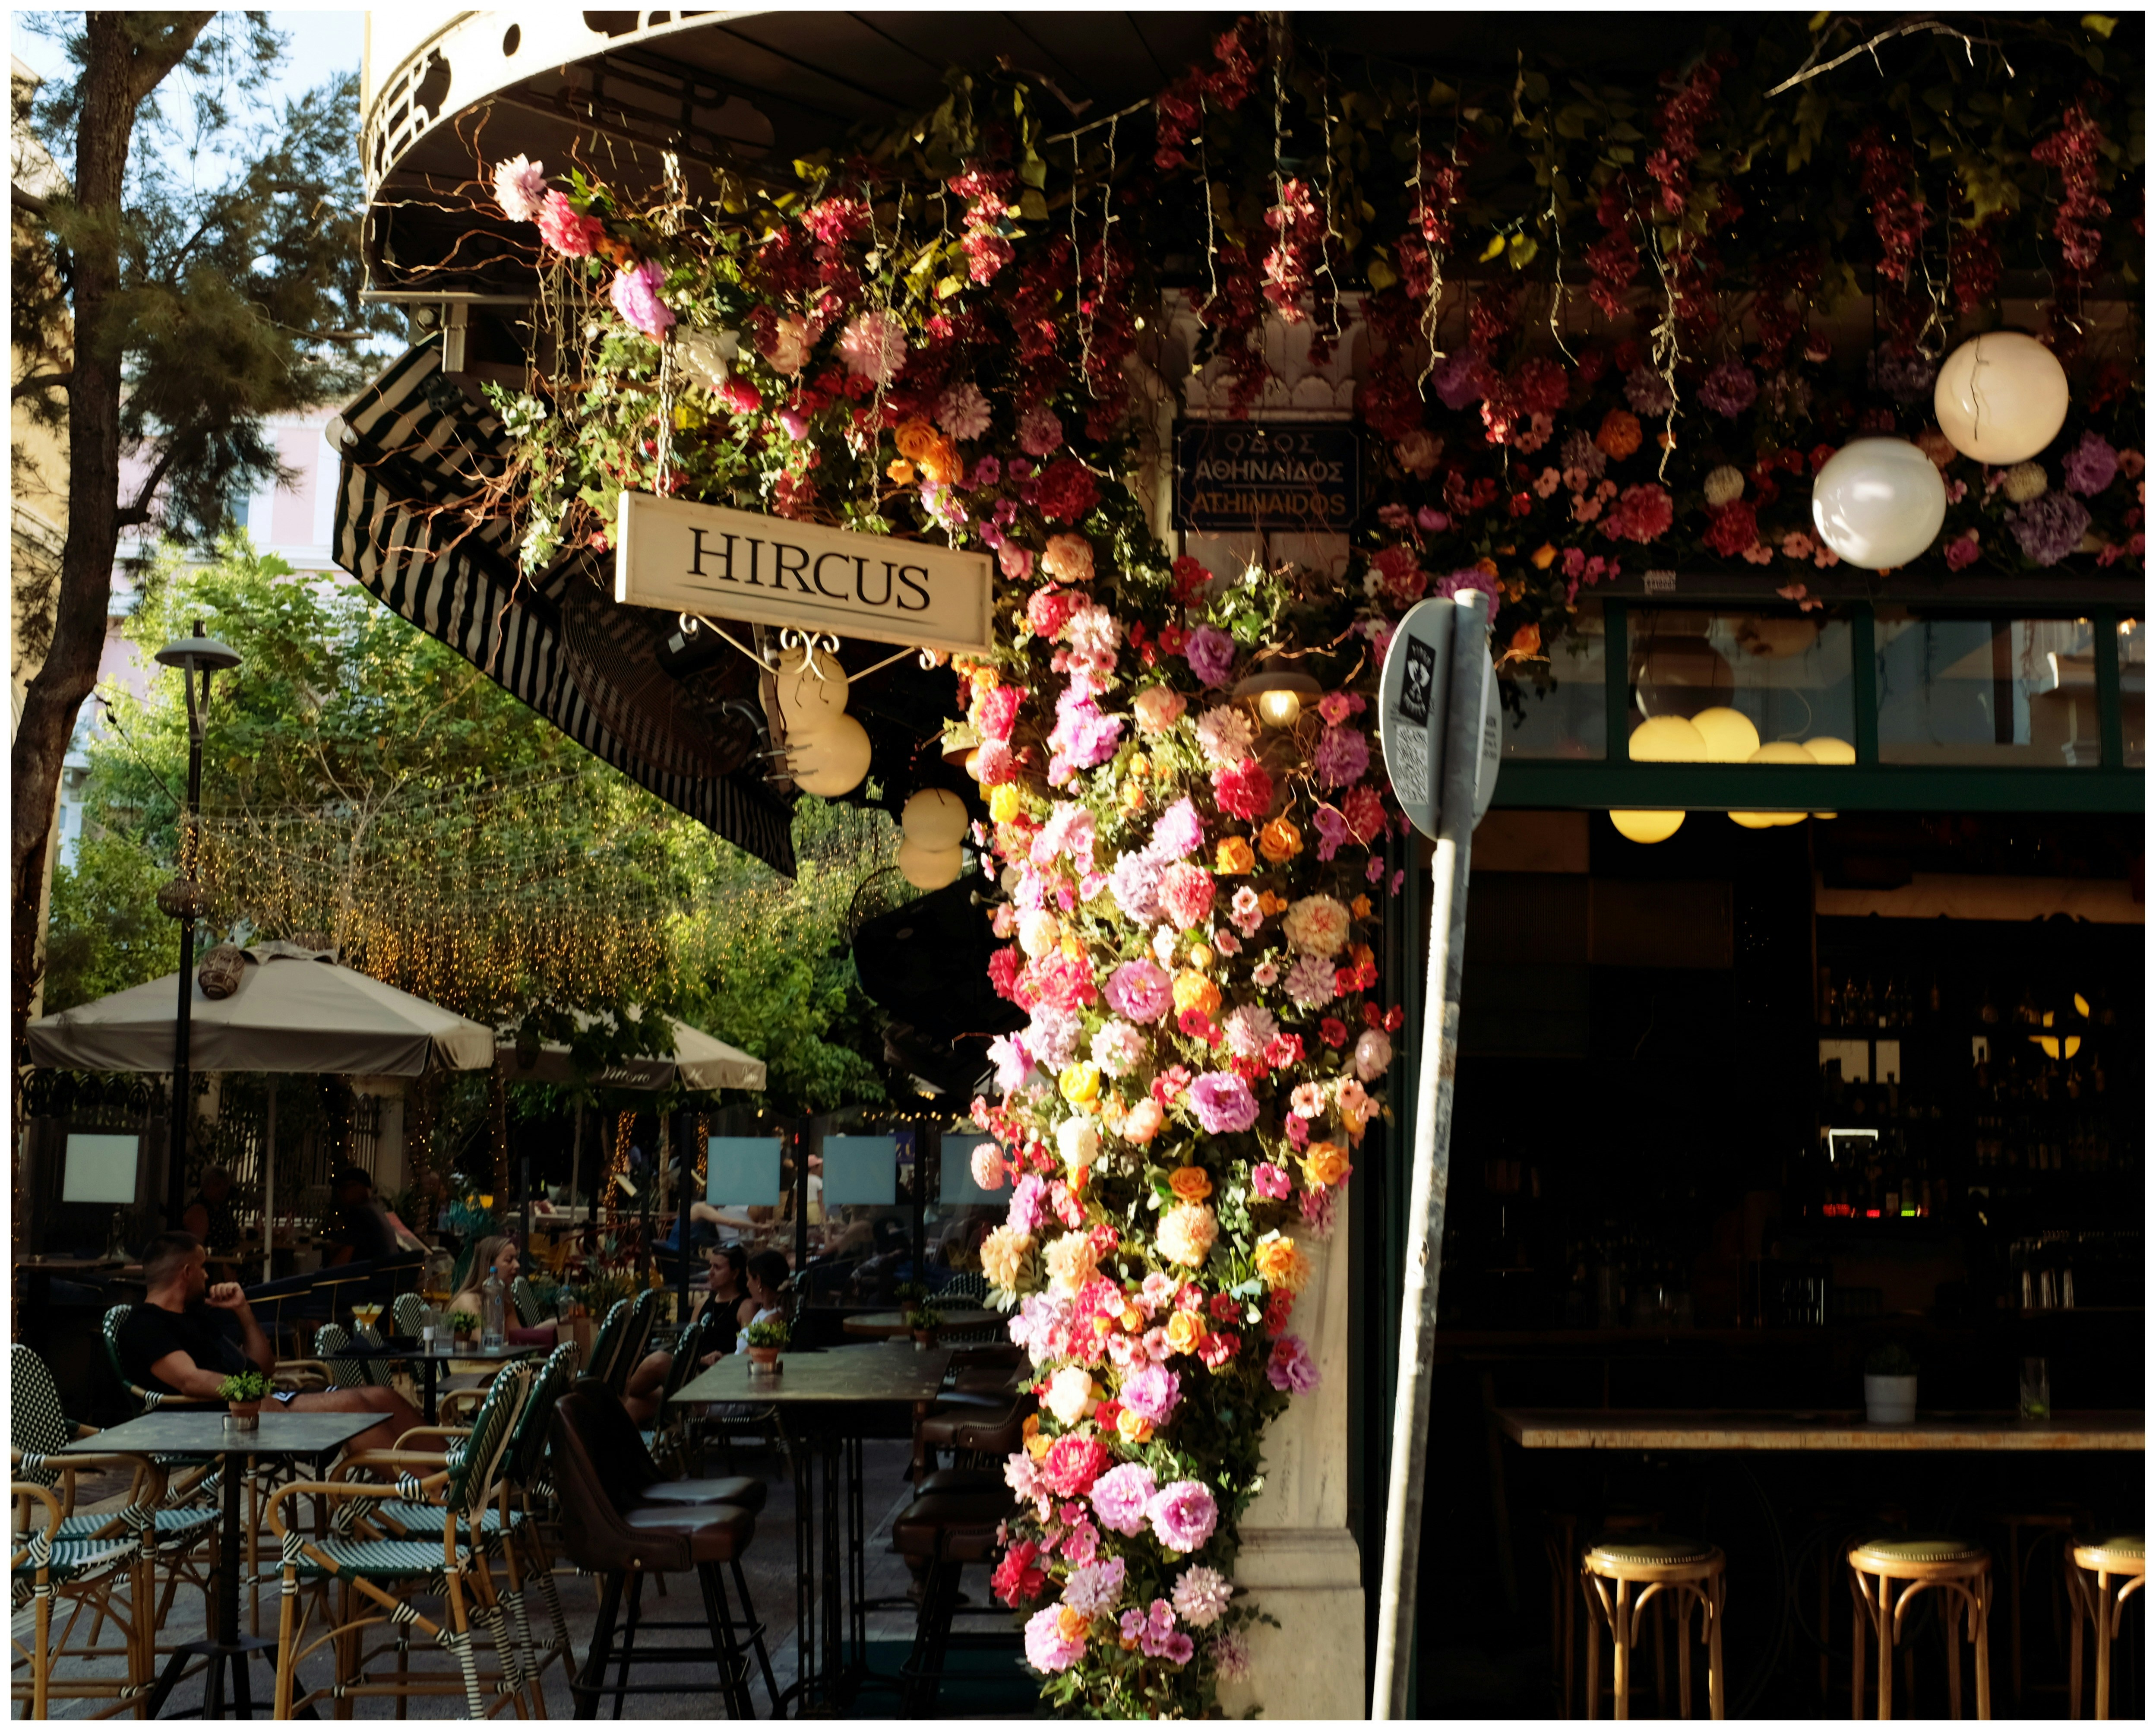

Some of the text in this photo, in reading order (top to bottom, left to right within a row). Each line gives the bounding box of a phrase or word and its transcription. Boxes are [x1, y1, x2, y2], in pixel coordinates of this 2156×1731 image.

[1224, 433, 1314, 453] ΟΔΟΣ
[1194, 492, 1347, 516] ATHINAIDOS
[687, 526, 931, 611] HIRCUS
